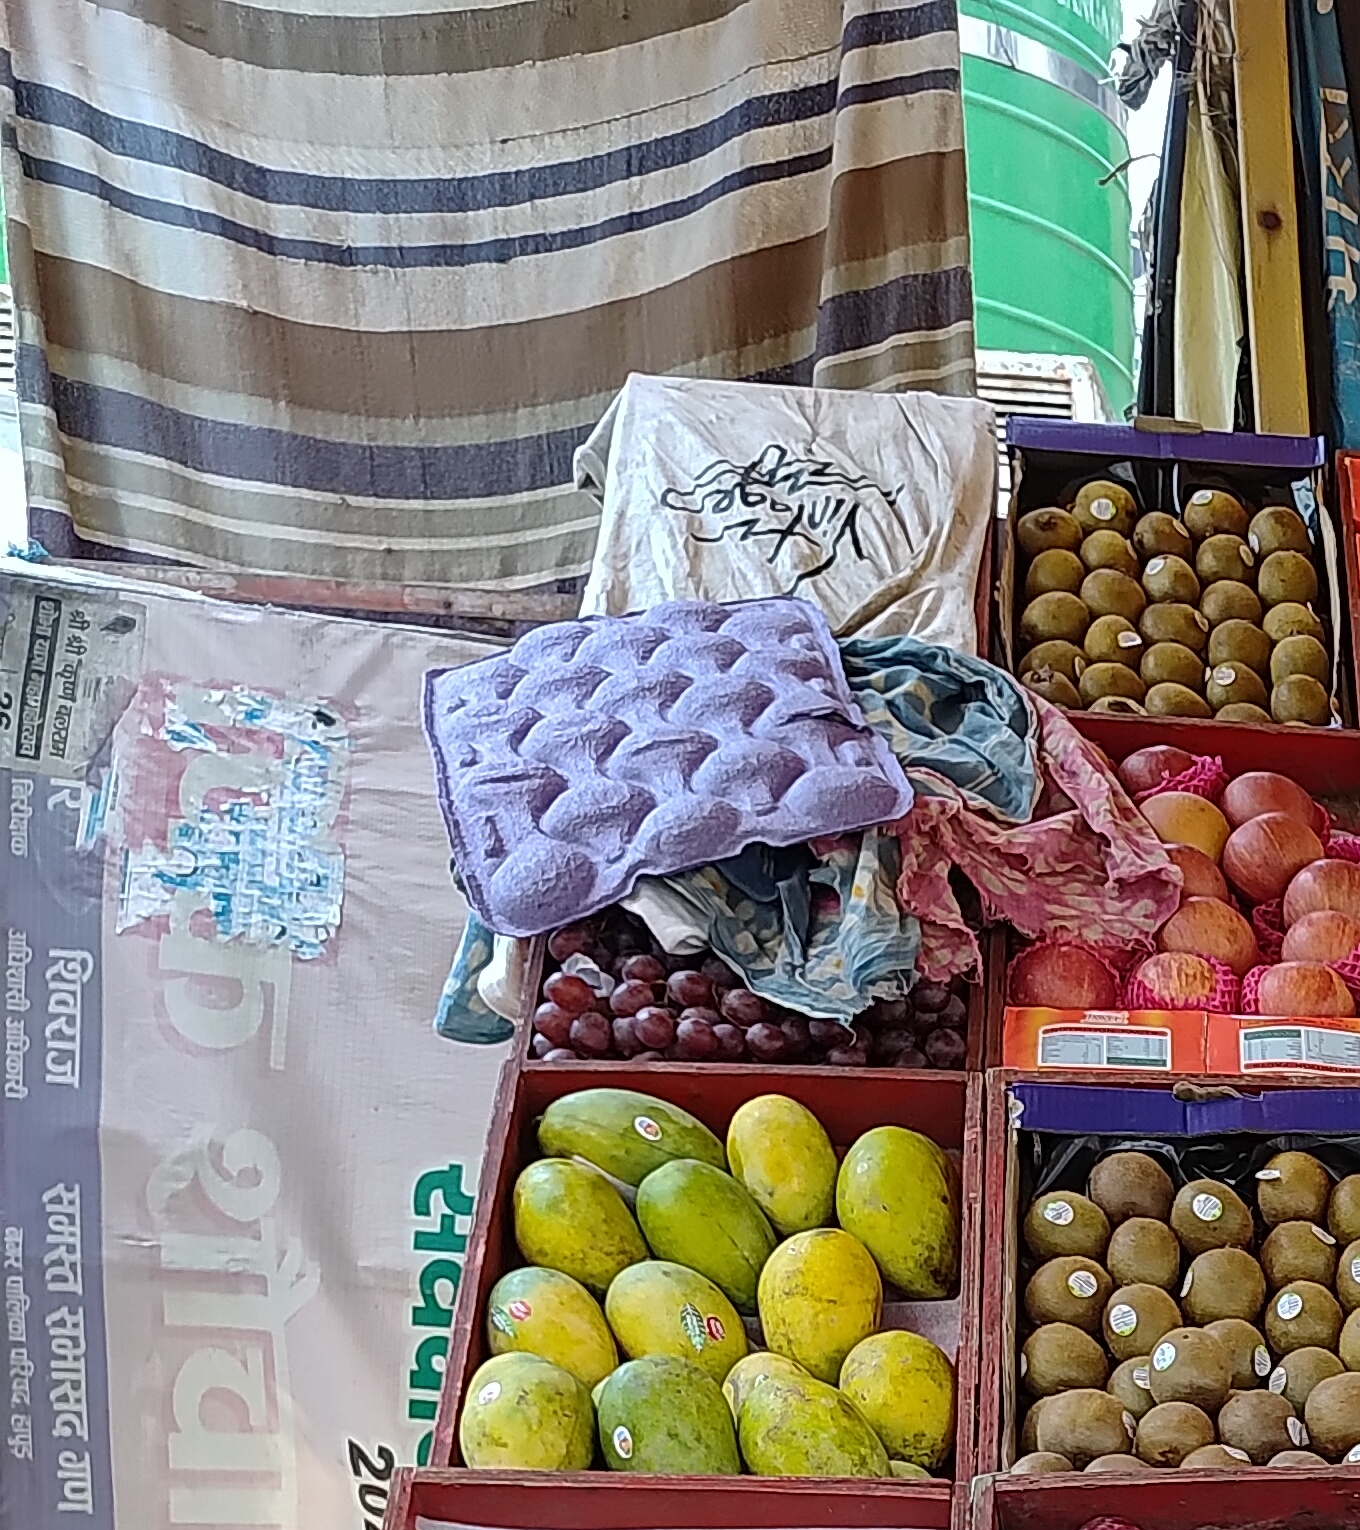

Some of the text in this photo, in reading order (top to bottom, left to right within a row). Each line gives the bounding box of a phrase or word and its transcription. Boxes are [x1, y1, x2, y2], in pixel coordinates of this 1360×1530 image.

[45, 948, 95, 1090] शिवराज
[5, 1226, 31, 1270] नगर
[5, 1277, 32, 1342] पालिका
[41, 1183, 95, 1514] समस्त सभासद गण
